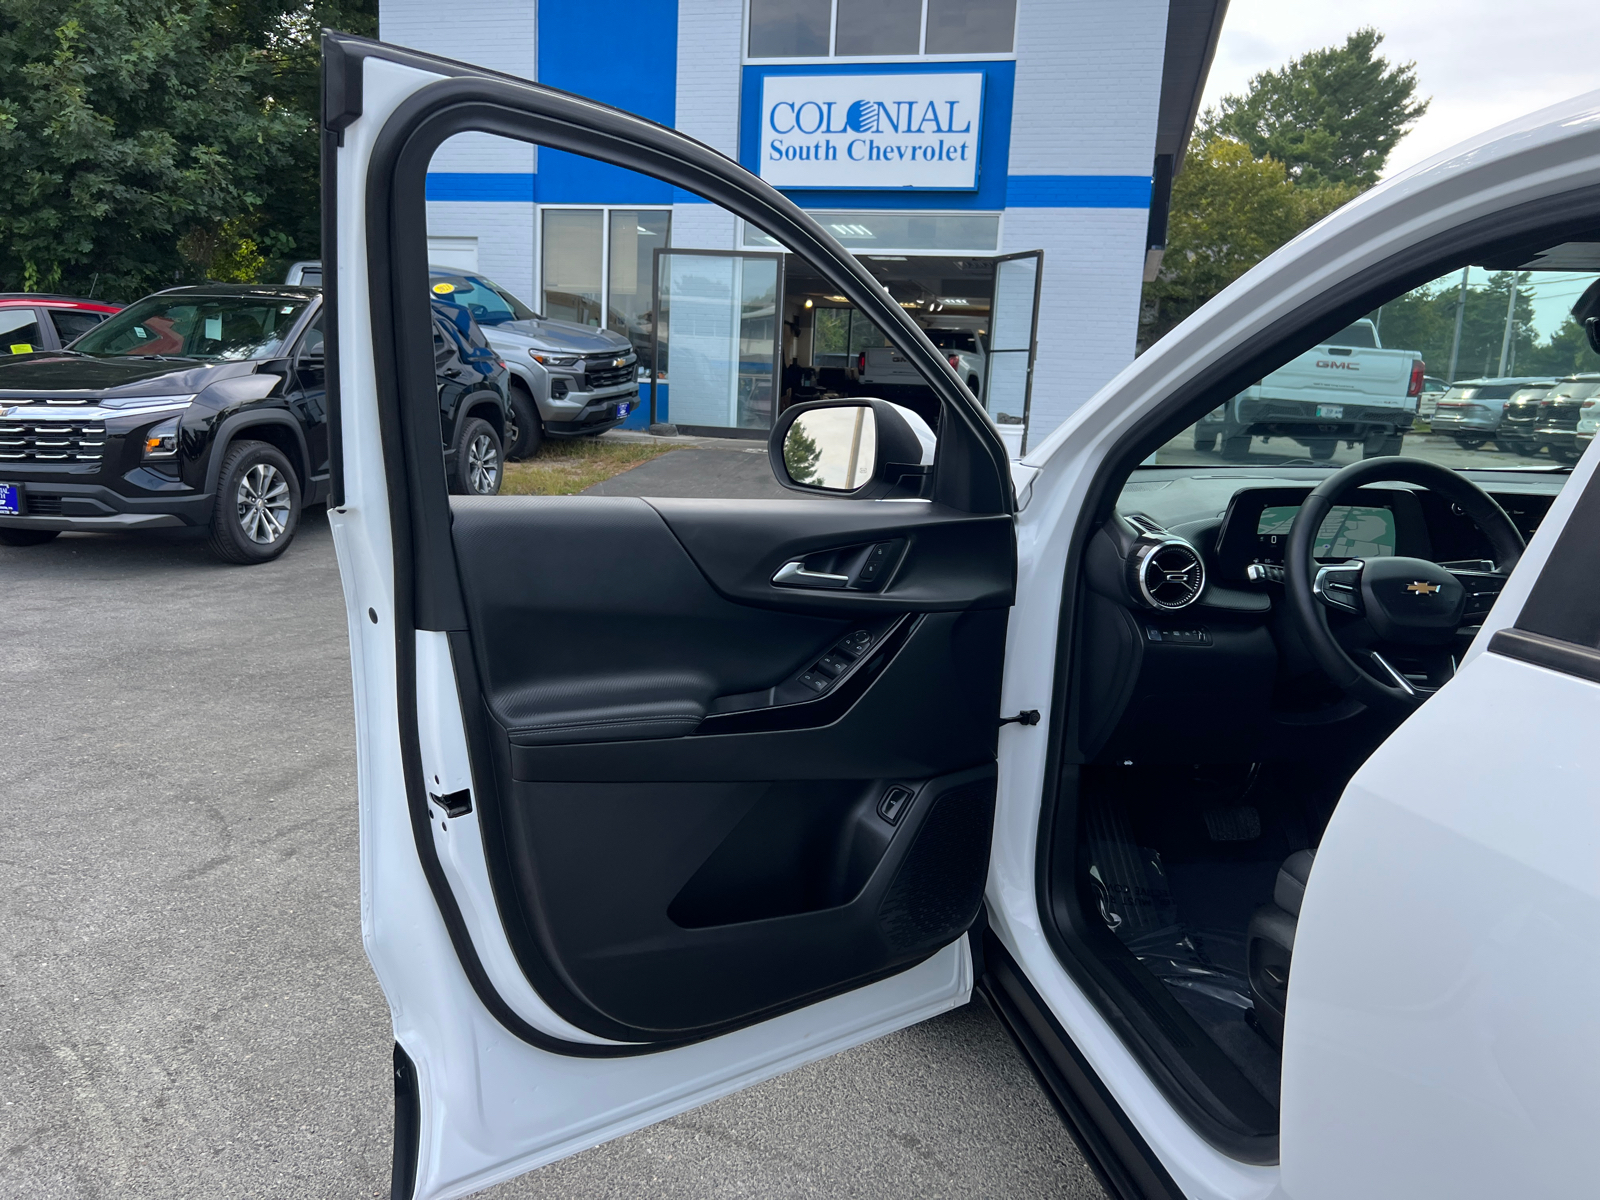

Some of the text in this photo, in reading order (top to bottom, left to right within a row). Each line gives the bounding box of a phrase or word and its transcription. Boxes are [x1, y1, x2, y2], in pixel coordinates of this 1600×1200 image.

[770, 99, 971, 134] COLONIAL
[770, 138, 970, 161] South Chevrolet
[1316, 360, 1360, 371] GMC
